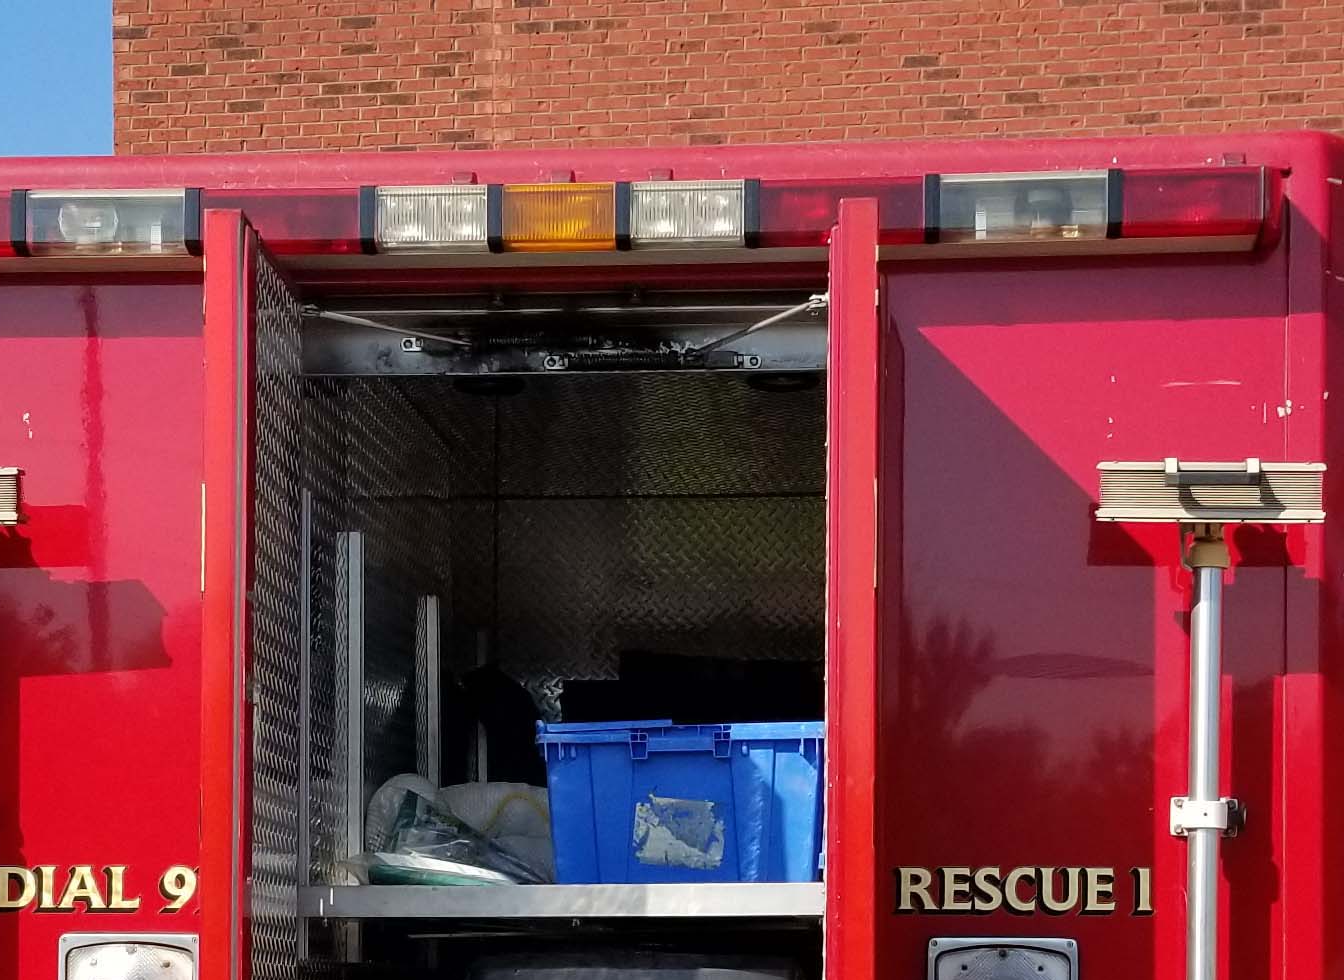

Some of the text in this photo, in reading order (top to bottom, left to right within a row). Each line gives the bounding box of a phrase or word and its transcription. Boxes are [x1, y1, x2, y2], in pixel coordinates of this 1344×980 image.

[158, 865, 200, 914] 9
[893, 866, 1155, 916] RESCUE 1
